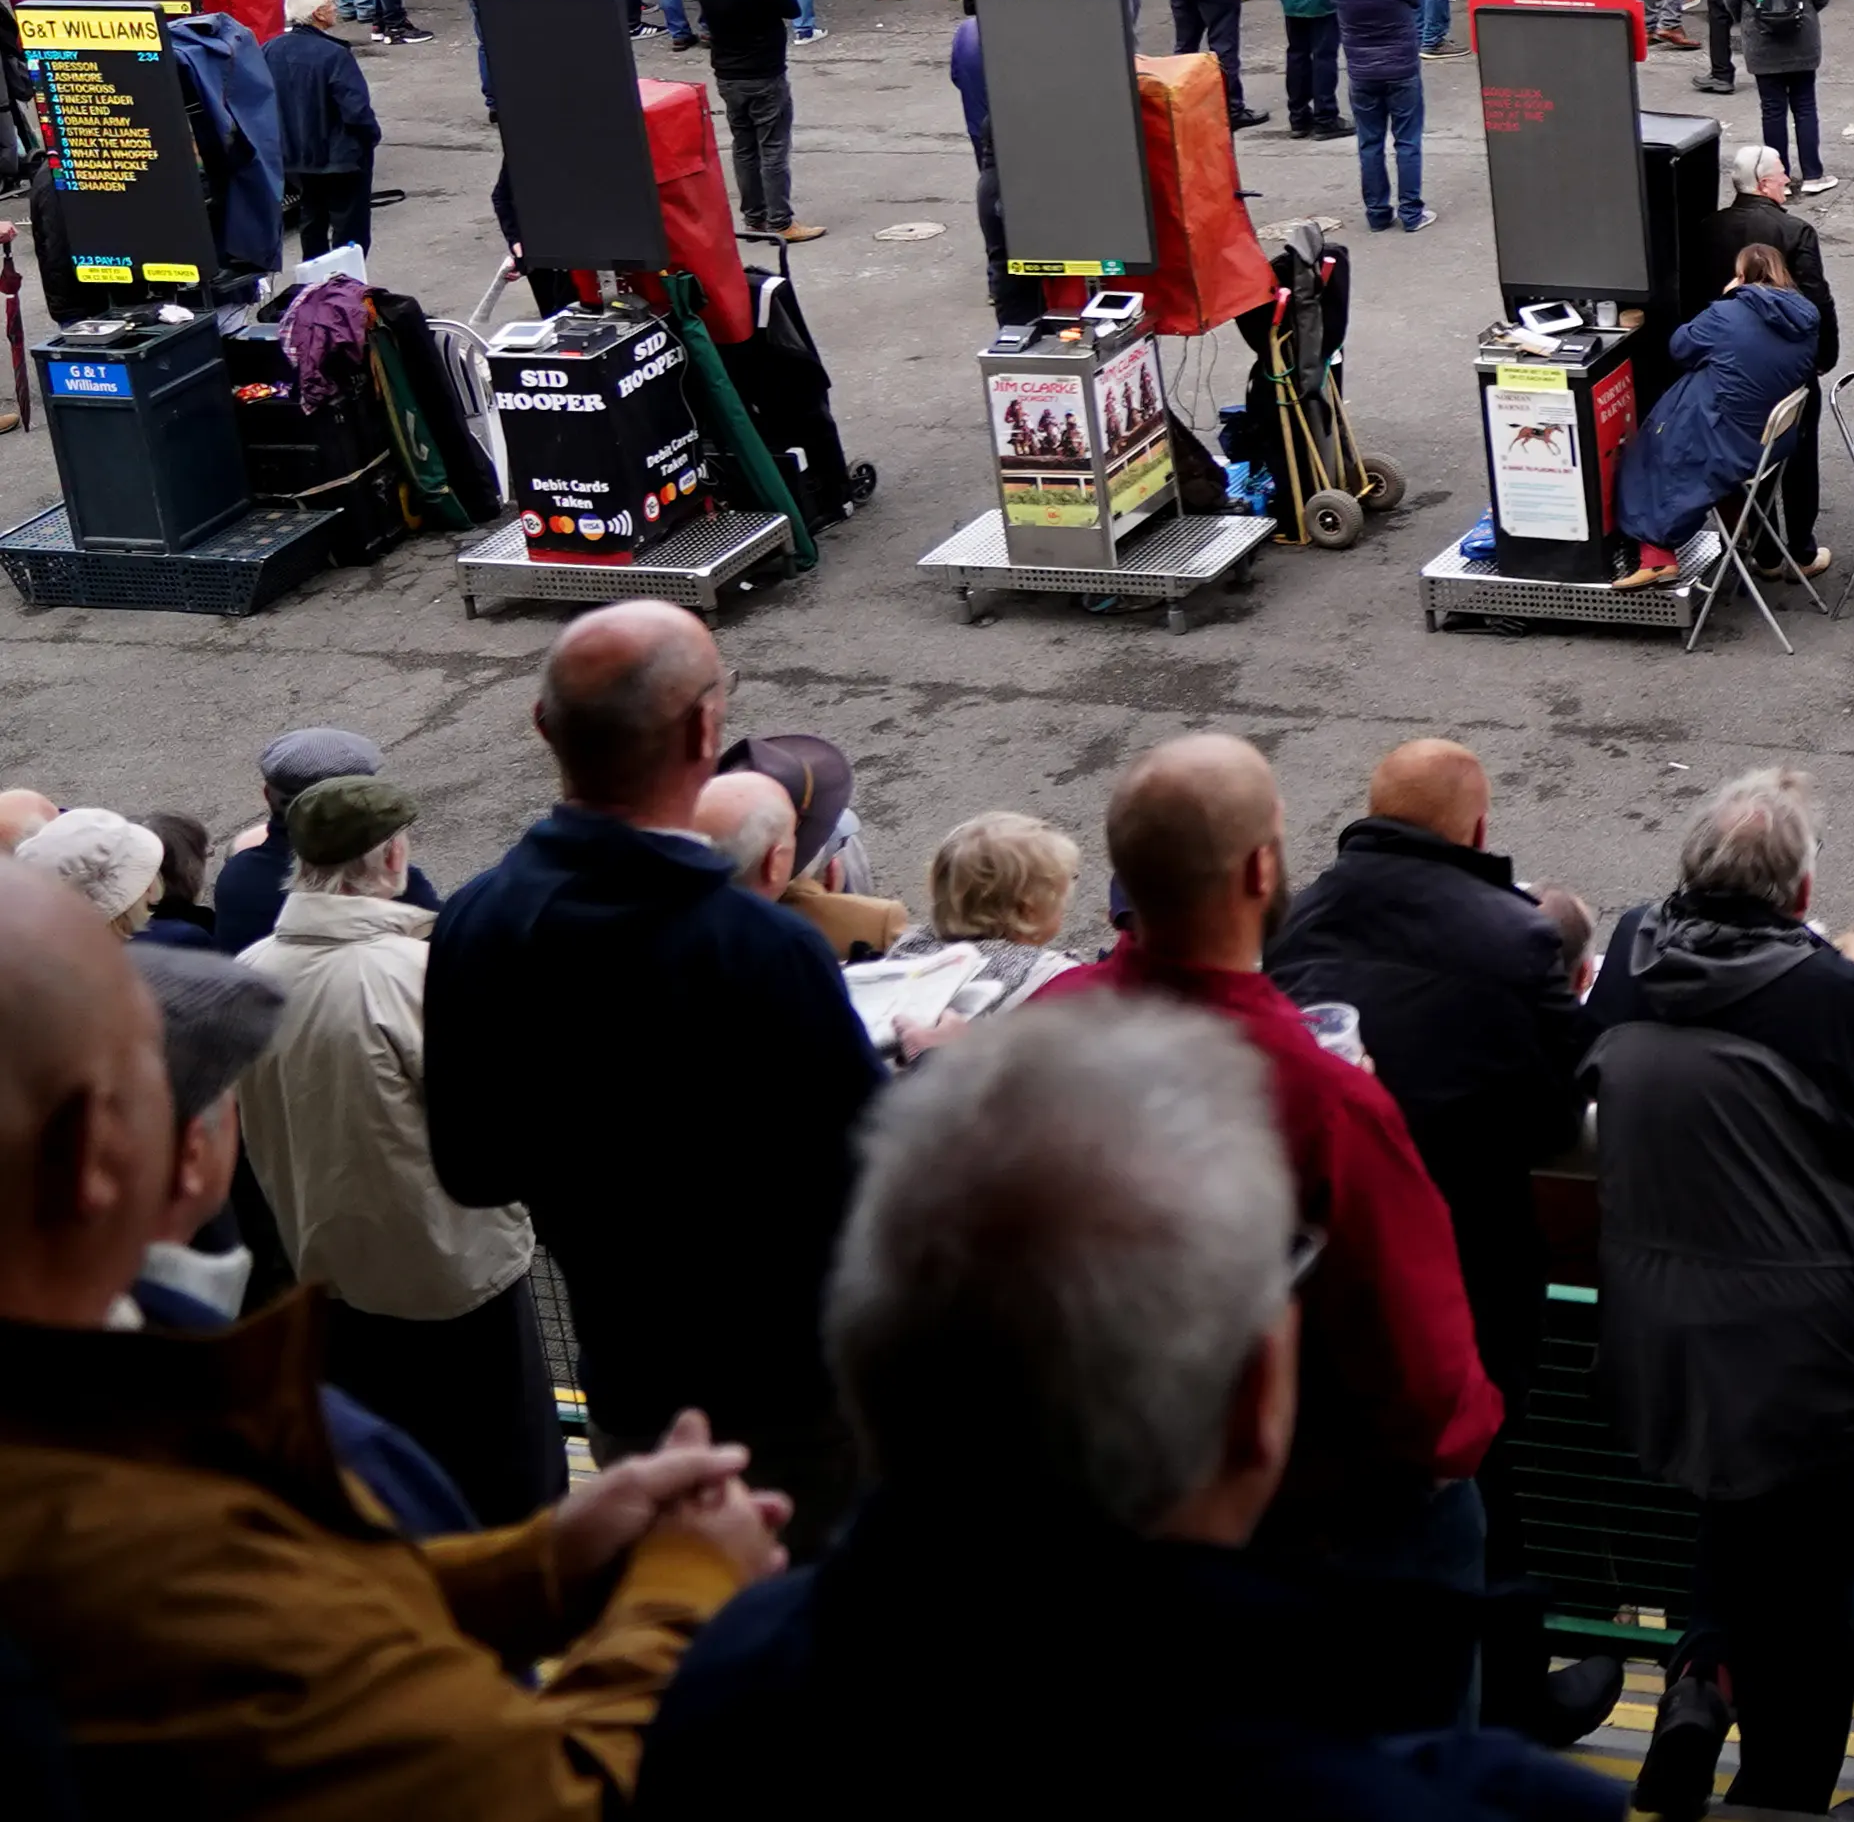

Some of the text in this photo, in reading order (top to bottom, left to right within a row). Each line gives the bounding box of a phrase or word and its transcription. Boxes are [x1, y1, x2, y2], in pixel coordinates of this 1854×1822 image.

[21, 20, 158, 40] G&T WILLIAMS
[24, 50, 79, 61] SALISBURY
[51, 62, 99, 72] BRESSON
[46, 72, 104, 83] 2 ASHMORE
[50, 83, 116, 94] 3 ECTOCROSS
[52, 95, 134, 106] 4 FINEST LEADER
[55, 105, 110, 116] 5 HALE END
[57, 116, 131, 127] 6 OBAMA ARMY
[59, 127, 151, 138] 7 STRIKE ALLIANCE
[62, 138, 152, 148] 8 WALK THE MOON
[64, 148, 71, 158] 9
[71, 149, 100, 158] WHAT
[102, 149, 111, 158] A
[61, 159, 149, 171] 10 MADAM PICKLE
[64, 170, 137, 181] 11 REMARQUEE
[66, 181, 126, 192] 12 SHAADEN
[633, 331, 668, 361] SID
[69, 365, 106, 378] G & T
[520, 370, 568, 387] SID
[65, 379, 118, 392] Williams
[1021, 381, 1079, 395] CLARKE
[496, 392, 607, 411] HOOPER
[645, 429, 700, 469] Debit Cards
[660, 453, 689, 477] Taken
[531, 478, 610, 493] Debit Cards
[552, 495, 594, 509] Taken
[525, 517, 541, 531] 18+
